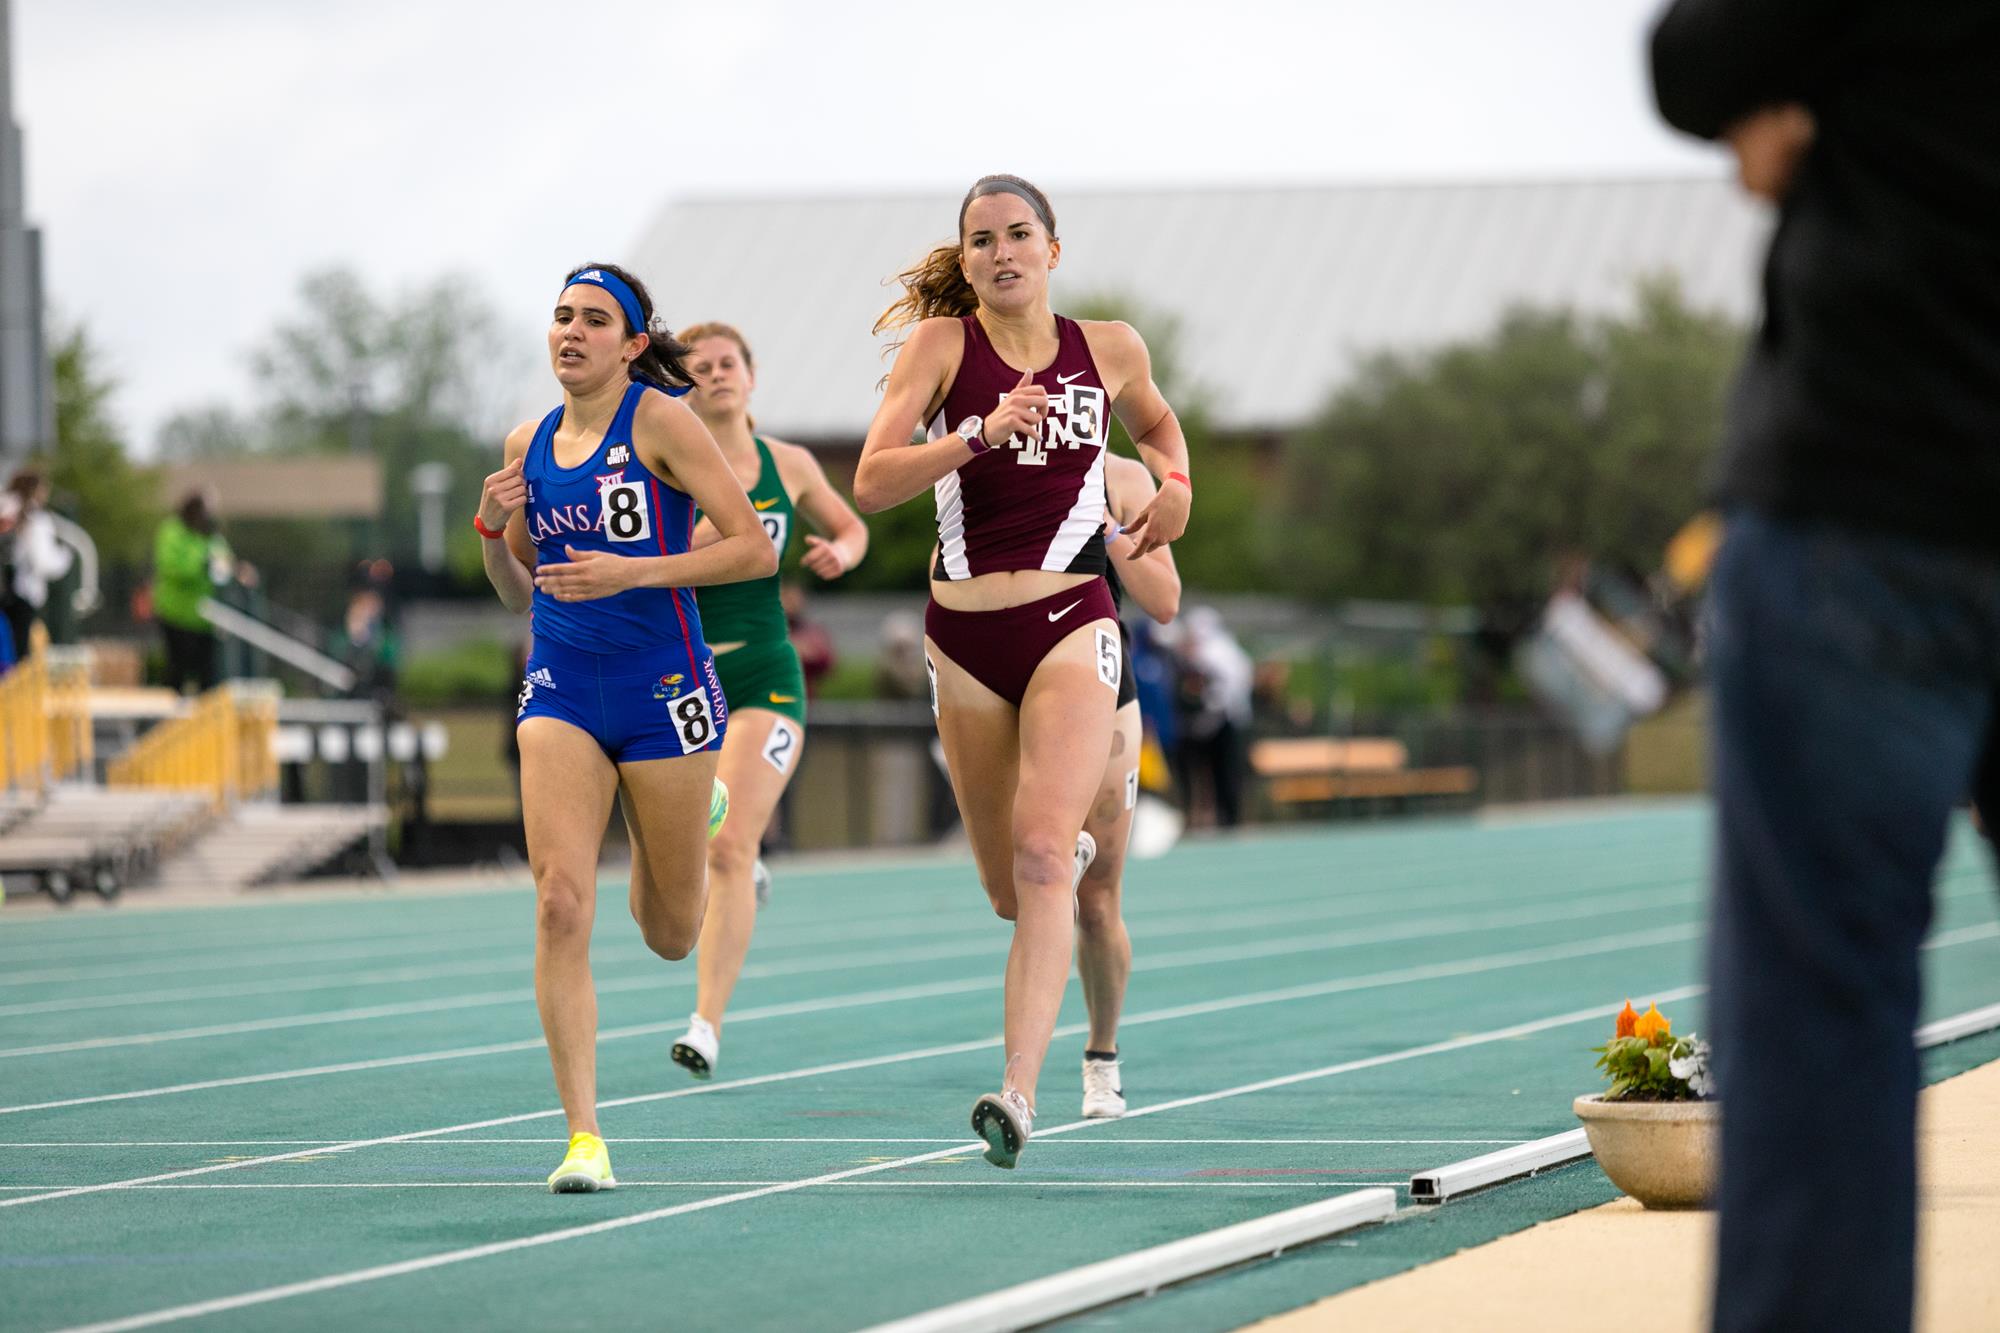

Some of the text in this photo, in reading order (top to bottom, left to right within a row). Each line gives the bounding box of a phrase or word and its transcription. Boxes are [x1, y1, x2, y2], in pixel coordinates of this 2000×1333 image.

[1072, 389, 1097, 439] 5
[610, 445, 626, 457] BLM
[608, 487, 642, 538] 8
[526, 675, 557, 690] adidas
[1100, 634, 1118, 685] 5
[677, 696, 709, 745] 8
[769, 727, 791, 767] 2
